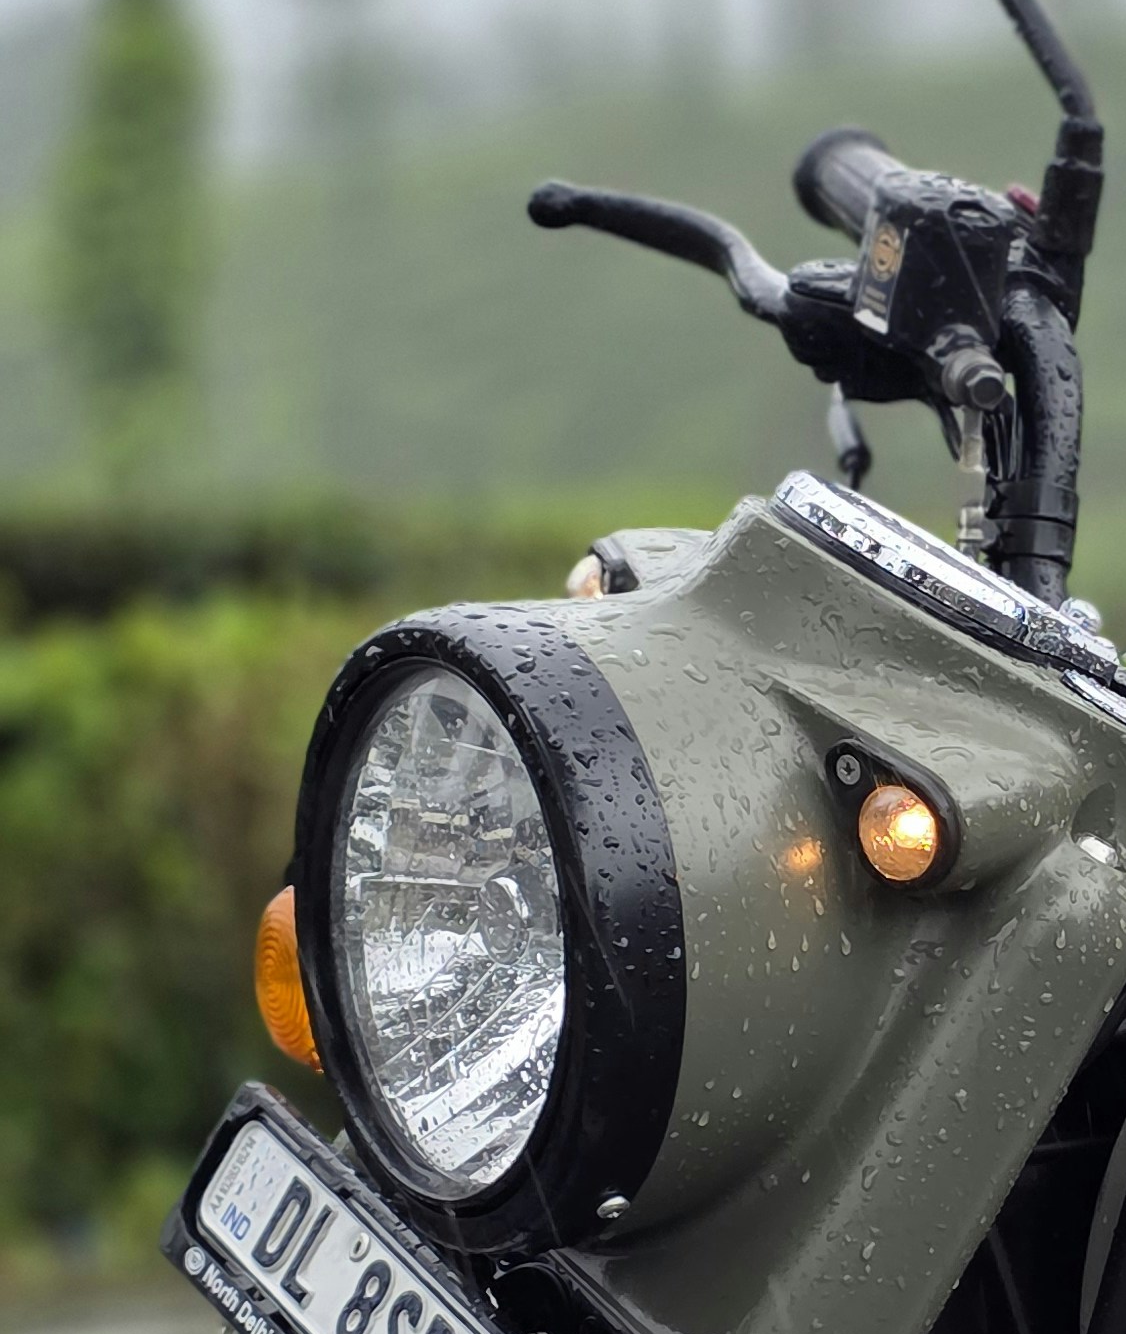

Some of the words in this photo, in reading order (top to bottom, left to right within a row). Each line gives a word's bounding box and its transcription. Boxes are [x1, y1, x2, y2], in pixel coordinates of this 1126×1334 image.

[220, 1201, 252, 1241] IND
[250, 1175, 337, 1306] DL
[202, 1263, 240, 1314] North
